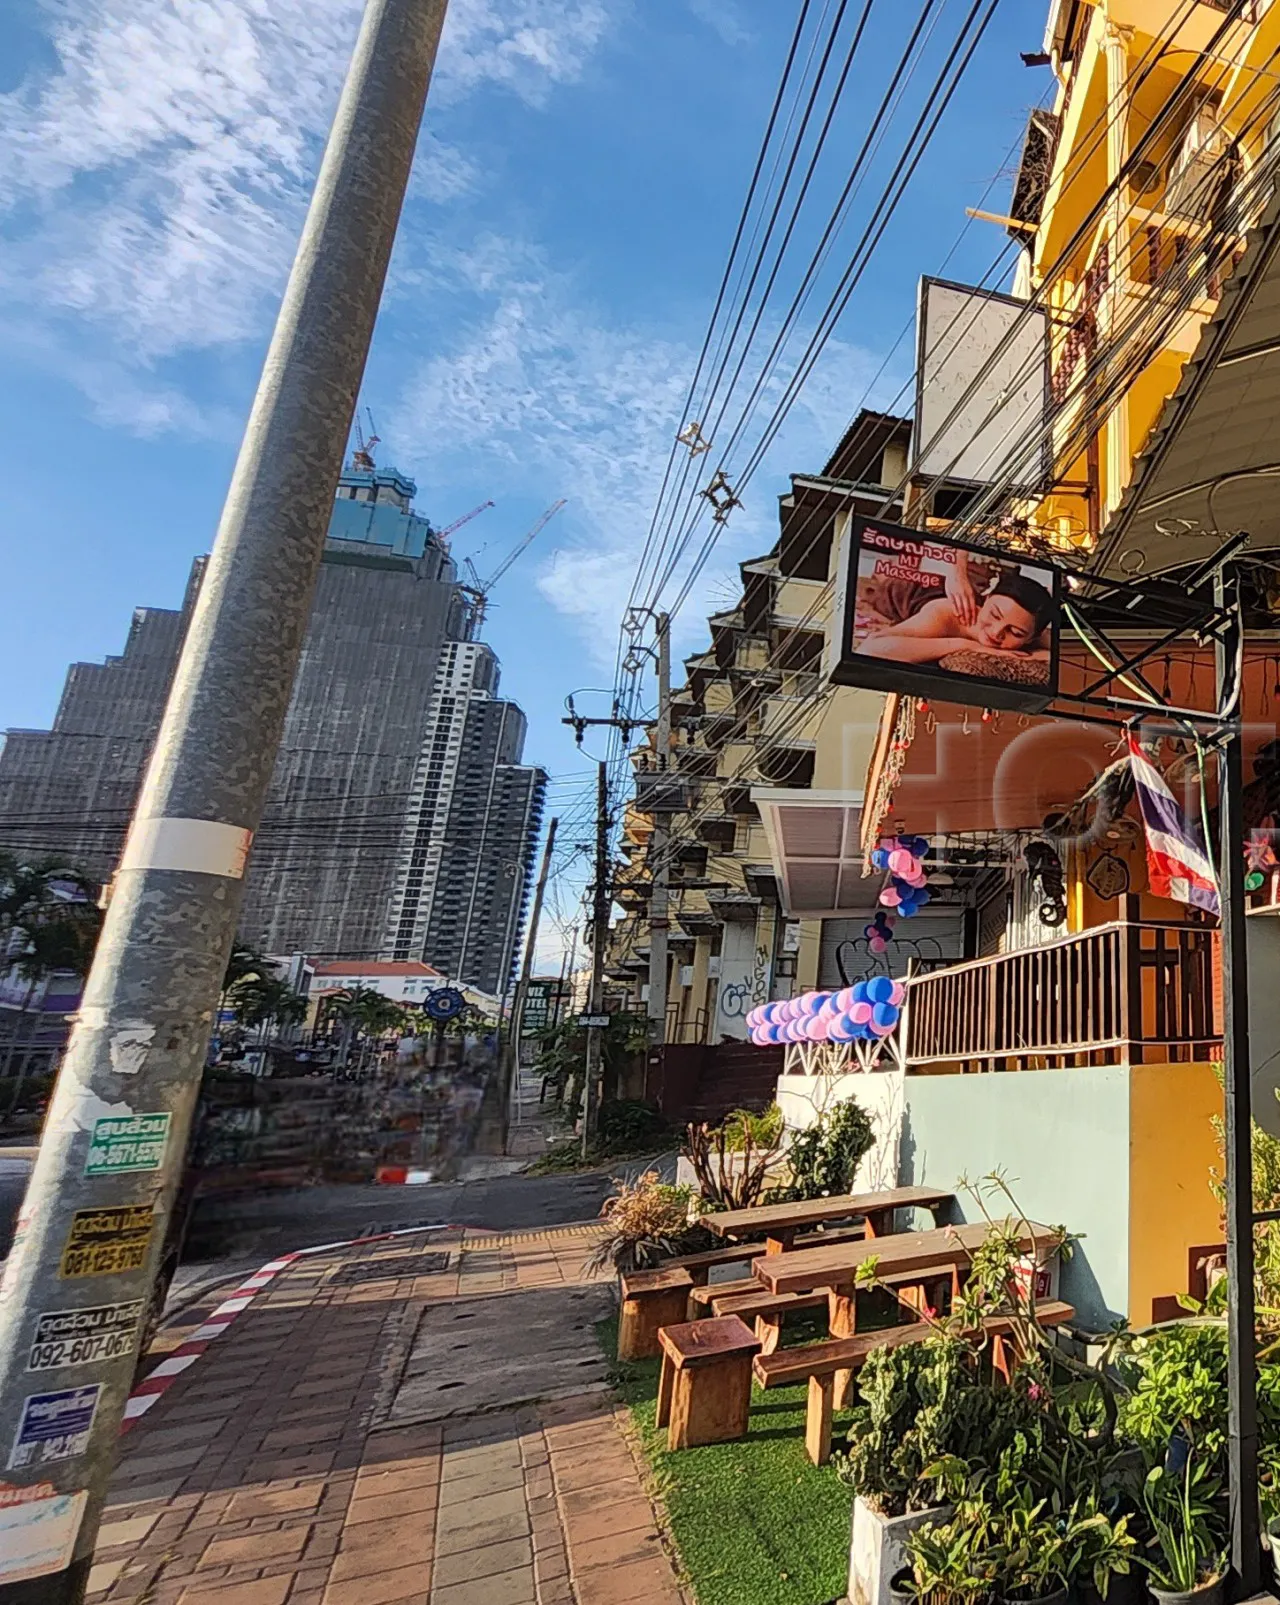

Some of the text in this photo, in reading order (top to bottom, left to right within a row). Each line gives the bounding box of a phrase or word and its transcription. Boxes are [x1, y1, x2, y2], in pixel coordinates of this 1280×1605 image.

[863, 527, 956, 563] รัตษณาวดี
[876, 561, 940, 588] Massage
